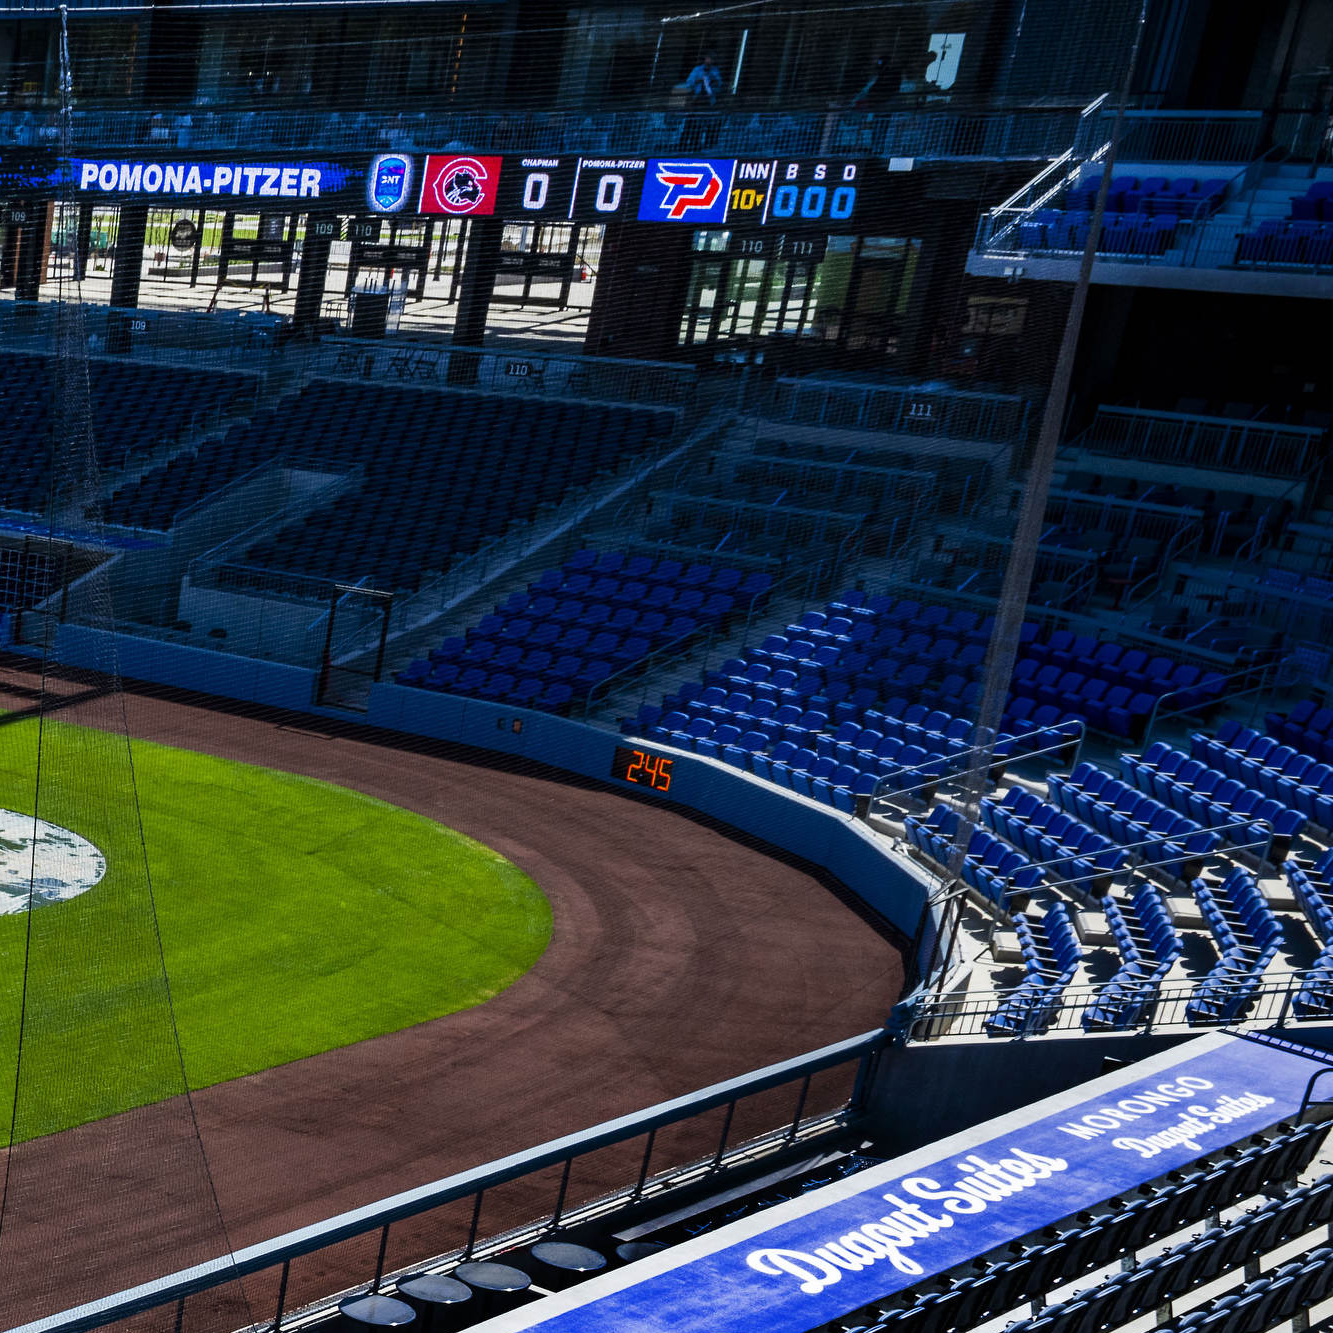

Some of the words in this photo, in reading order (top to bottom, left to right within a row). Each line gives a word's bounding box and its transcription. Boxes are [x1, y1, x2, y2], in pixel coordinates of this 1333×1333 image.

[521, 159, 559, 167] CHAPMAN
[582, 160, 646, 168] POMONA-PITZER
[738, 163, 770, 179] INN
[785, 163, 799, 180] B
[812, 164, 827, 180] S
[79, 163, 322, 197] POMONA-PITZER
[523, 173, 549, 209] 0
[596, 174, 624, 211] 0
[732, 189, 756, 210] 10
[315, 223, 334, 235] 109
[355, 225, 373, 236] 110
[741, 240, 763, 254] 110
[792, 241, 814, 255] 111
[508, 364, 529, 376] 110
[909, 403, 932, 417] 111
[1057, 1076, 1214, 1141] MORONGO
[1112, 1114, 1219, 1159] Dugout
[1196, 1092, 1274, 1131] Suites
[746, 1191, 954, 1294] Dugout
[901, 1146, 1068, 1217] Suites
